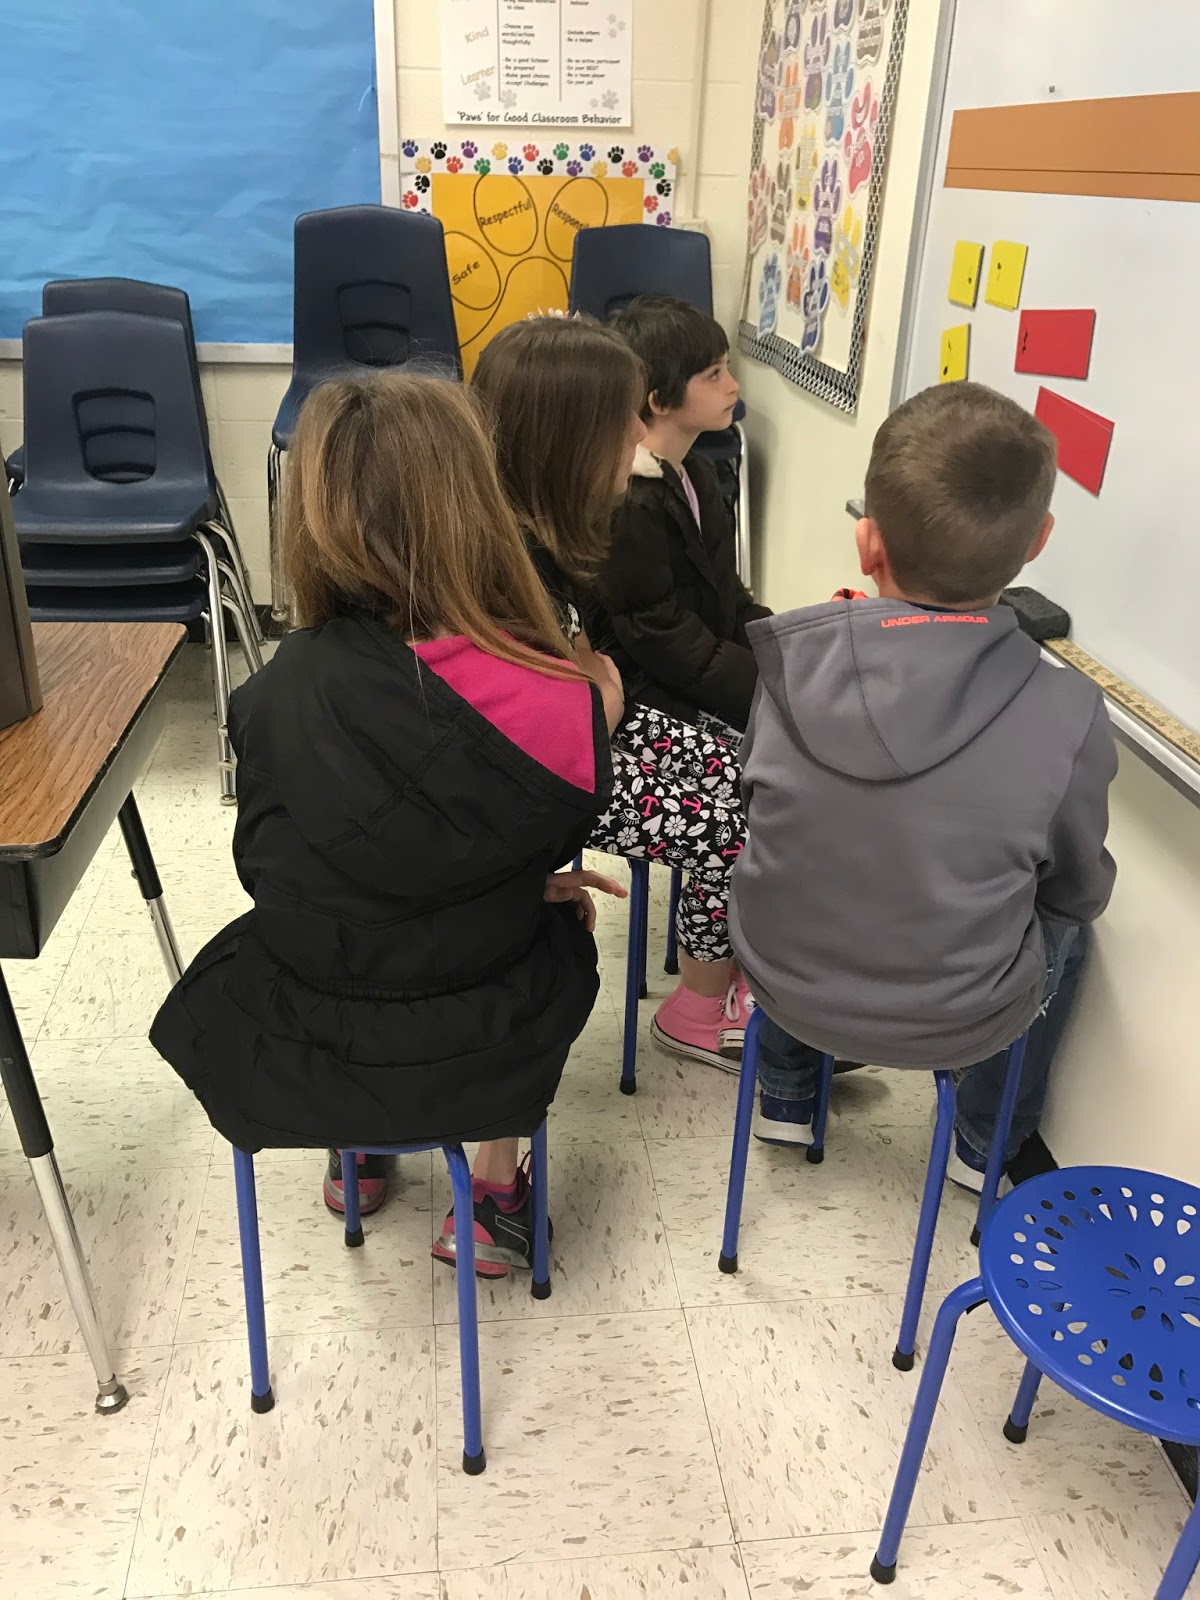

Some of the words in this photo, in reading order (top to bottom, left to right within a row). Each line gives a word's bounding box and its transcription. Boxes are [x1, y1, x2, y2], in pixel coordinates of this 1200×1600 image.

[465, 26, 490, 44] Kind
[460, 65, 495, 86] Learner
[487, 112, 500, 122] for
[504, 112, 528, 122] Good
[531, 113, 579, 123] Classroom
[582, 113, 622, 124] Behavior
[479, 197, 533, 228] Respectful
[452, 259, 481, 285] Safe
[880, 615, 931, 628] UNDER
[933, 615, 989, 624] ARMOUR
